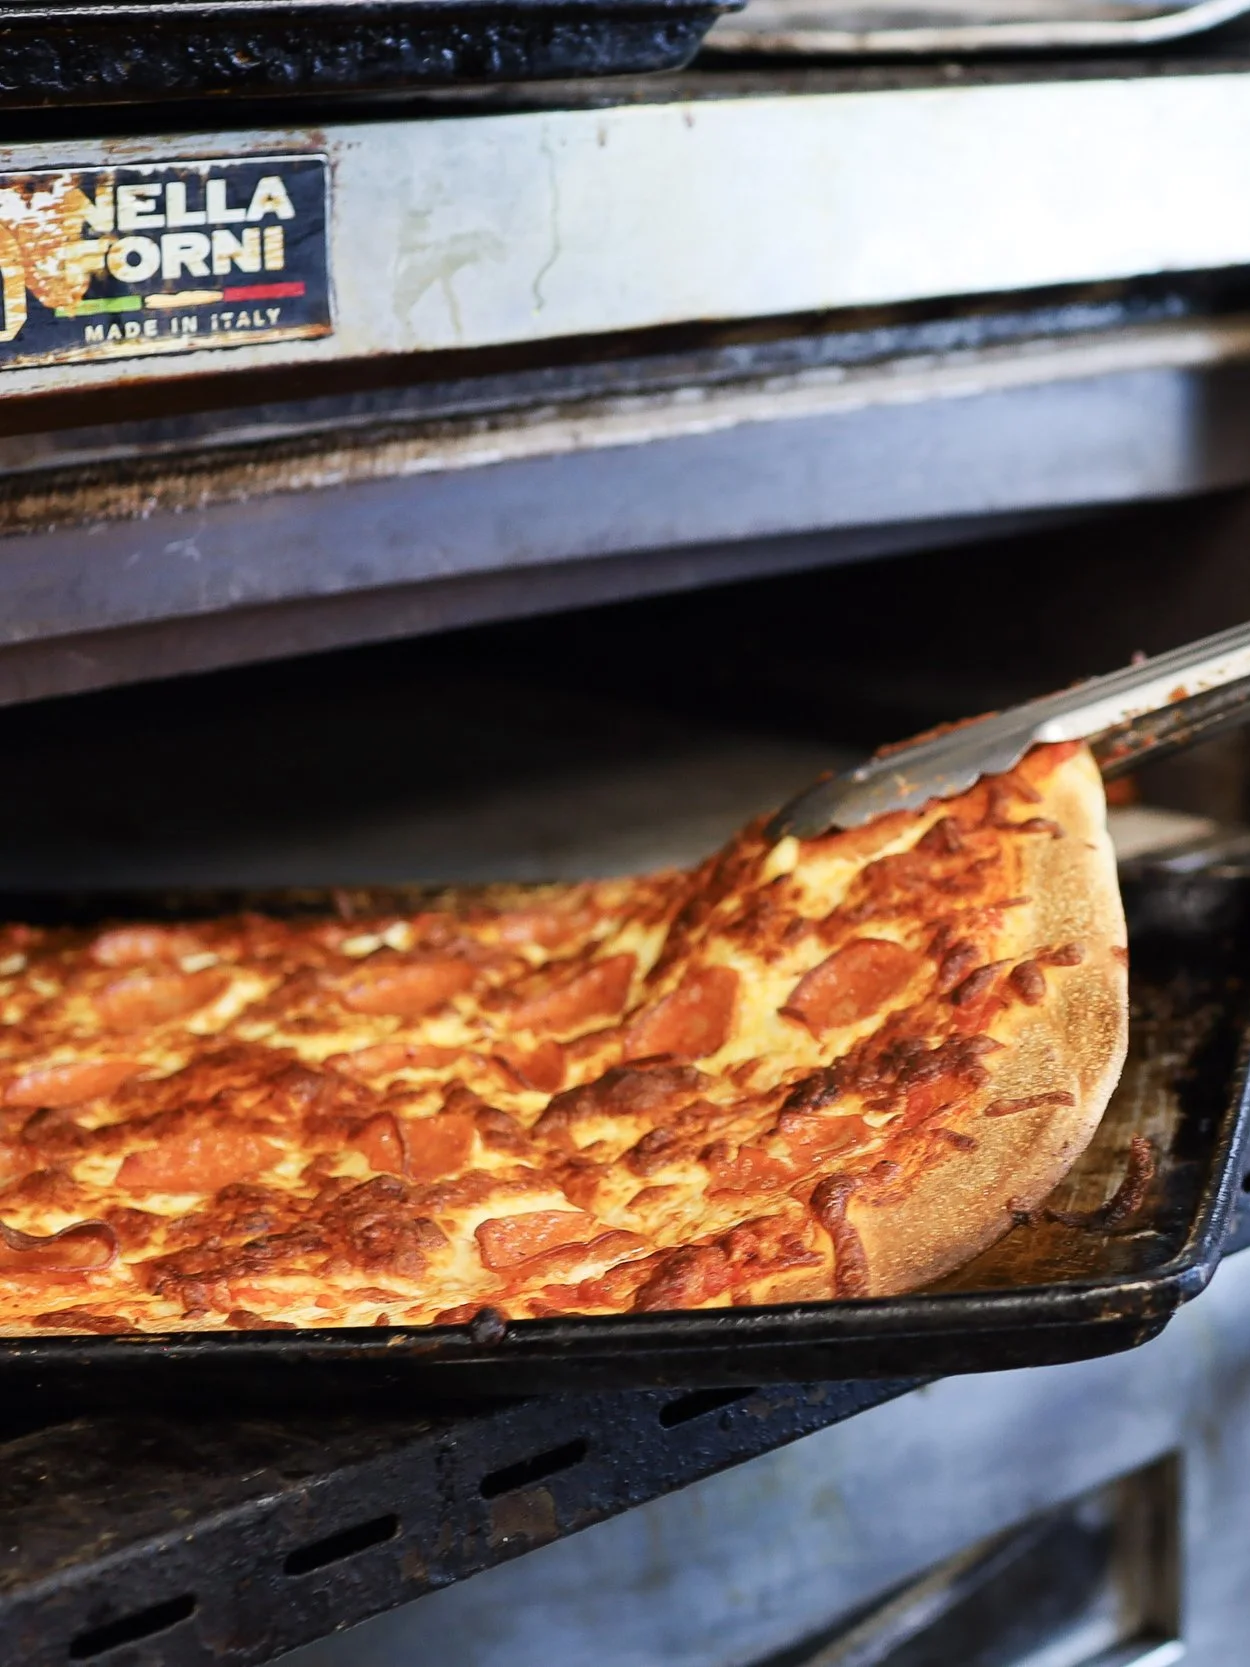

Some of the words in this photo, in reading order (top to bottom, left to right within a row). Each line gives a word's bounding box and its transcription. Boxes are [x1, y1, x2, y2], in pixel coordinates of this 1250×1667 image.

[63, 225, 285, 285] FORNI
[84, 319, 158, 343] MADE
[171, 315, 198, 334] IN
[210, 307, 282, 331] ITALY
